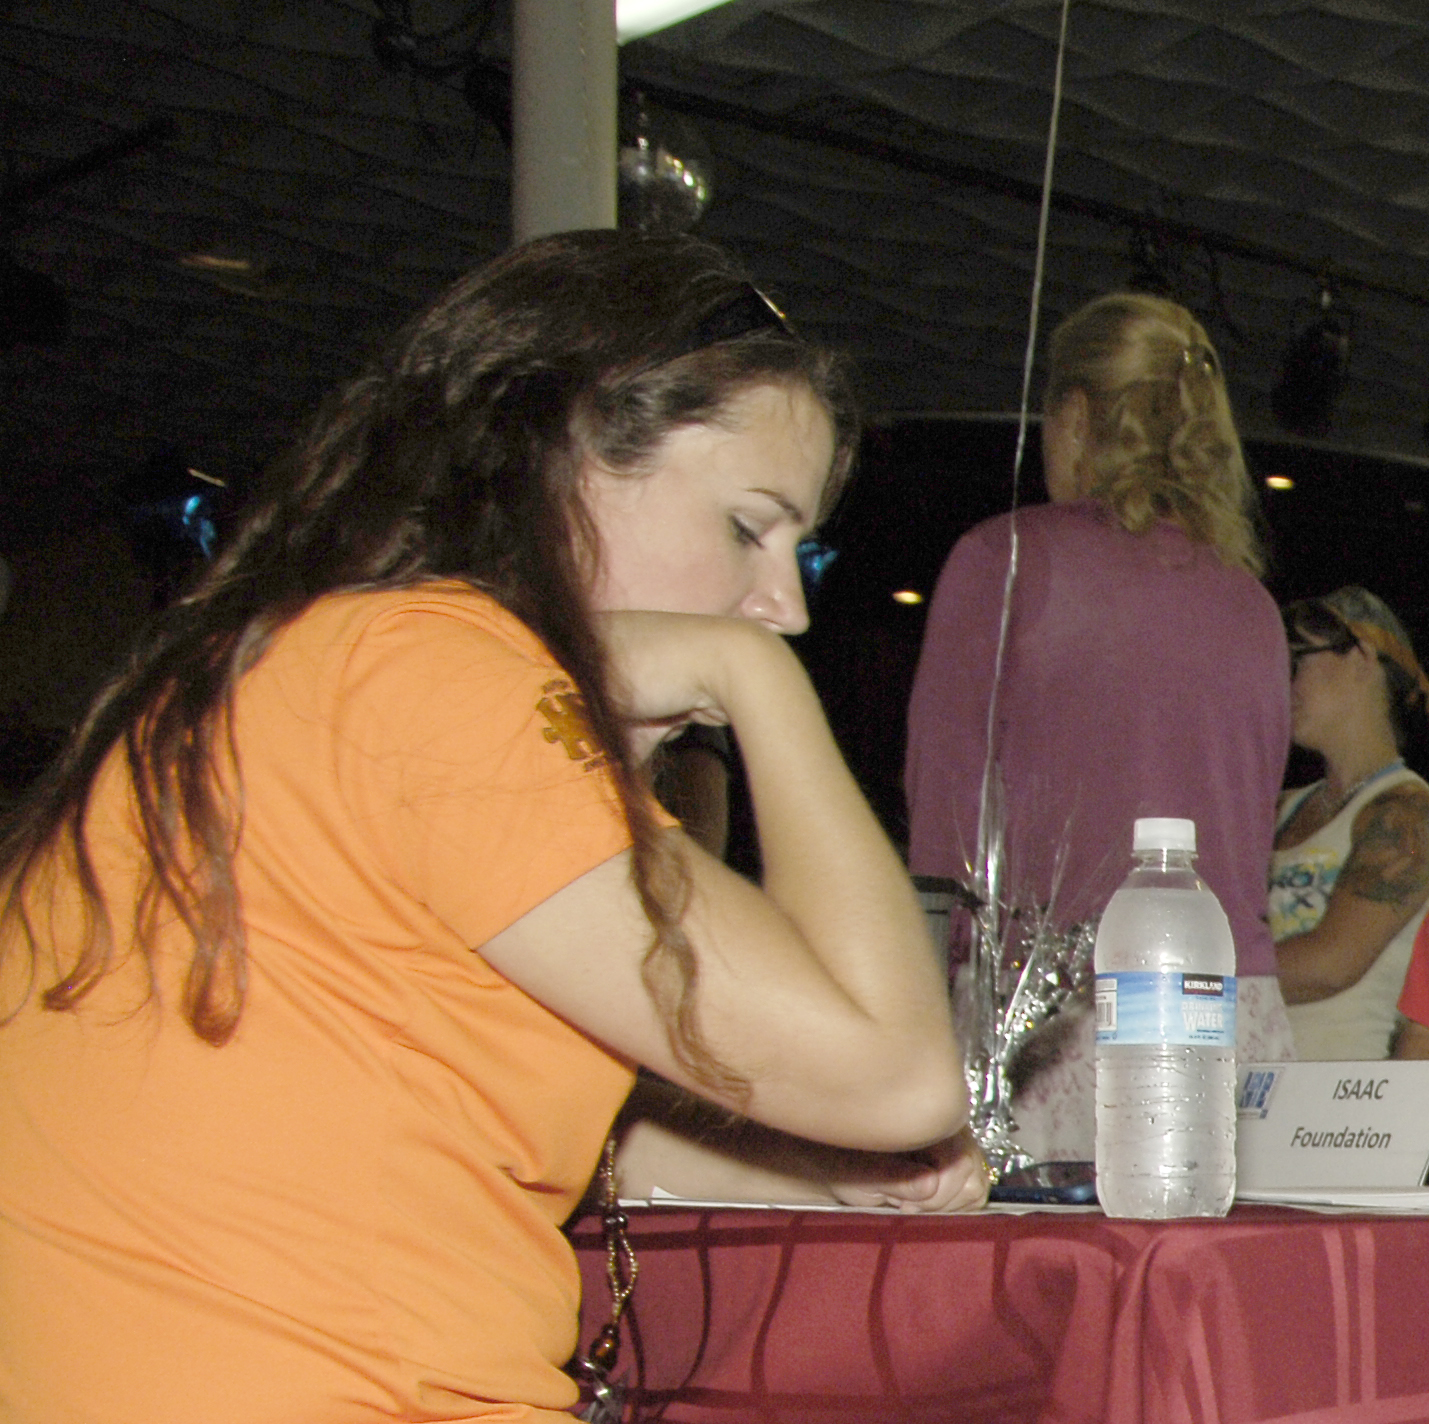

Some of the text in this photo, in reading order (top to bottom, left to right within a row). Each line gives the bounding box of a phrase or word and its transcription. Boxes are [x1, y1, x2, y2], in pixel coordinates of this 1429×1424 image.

[1183, 980, 1223, 991] KIRKLAND
[1182, 1011, 1223, 1031] WATER
[1332, 1078, 1389, 1100] ISAAC
[1290, 1126, 1392, 1149] Foundation
